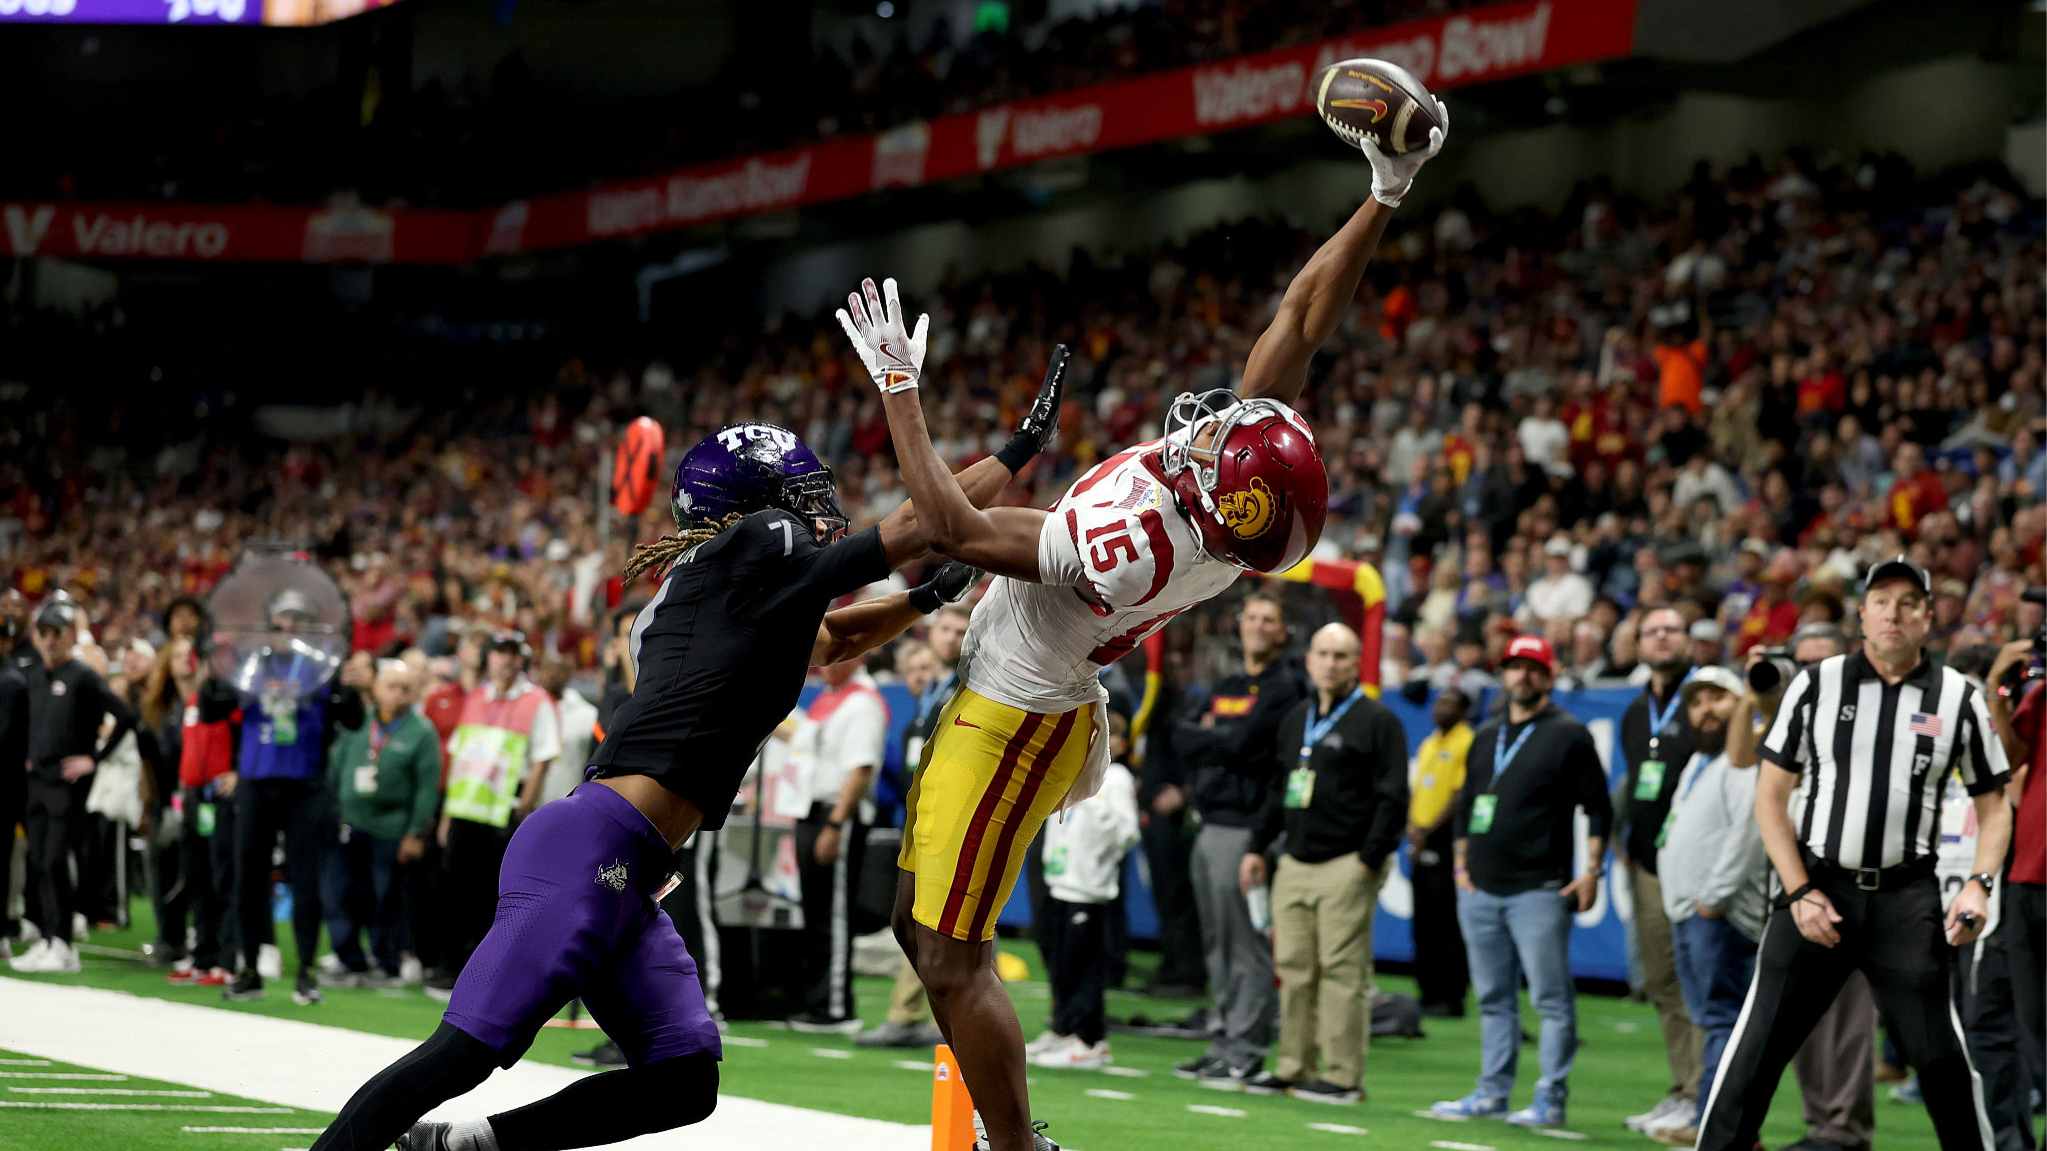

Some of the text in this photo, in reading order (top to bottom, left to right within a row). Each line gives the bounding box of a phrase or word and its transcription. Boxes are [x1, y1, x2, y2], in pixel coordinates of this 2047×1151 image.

[1193, 60, 1305, 126] Valero
[1438, 2, 1553, 80] Bowl
[1014, 104, 1103, 156] Valero
[71, 212, 230, 258] Valero
[717, 424, 797, 457] TCU
[768, 519, 793, 556] 7
[1086, 519, 1139, 573] 15
[1840, 705, 1854, 721] S
[1913, 755, 1930, 775] F
